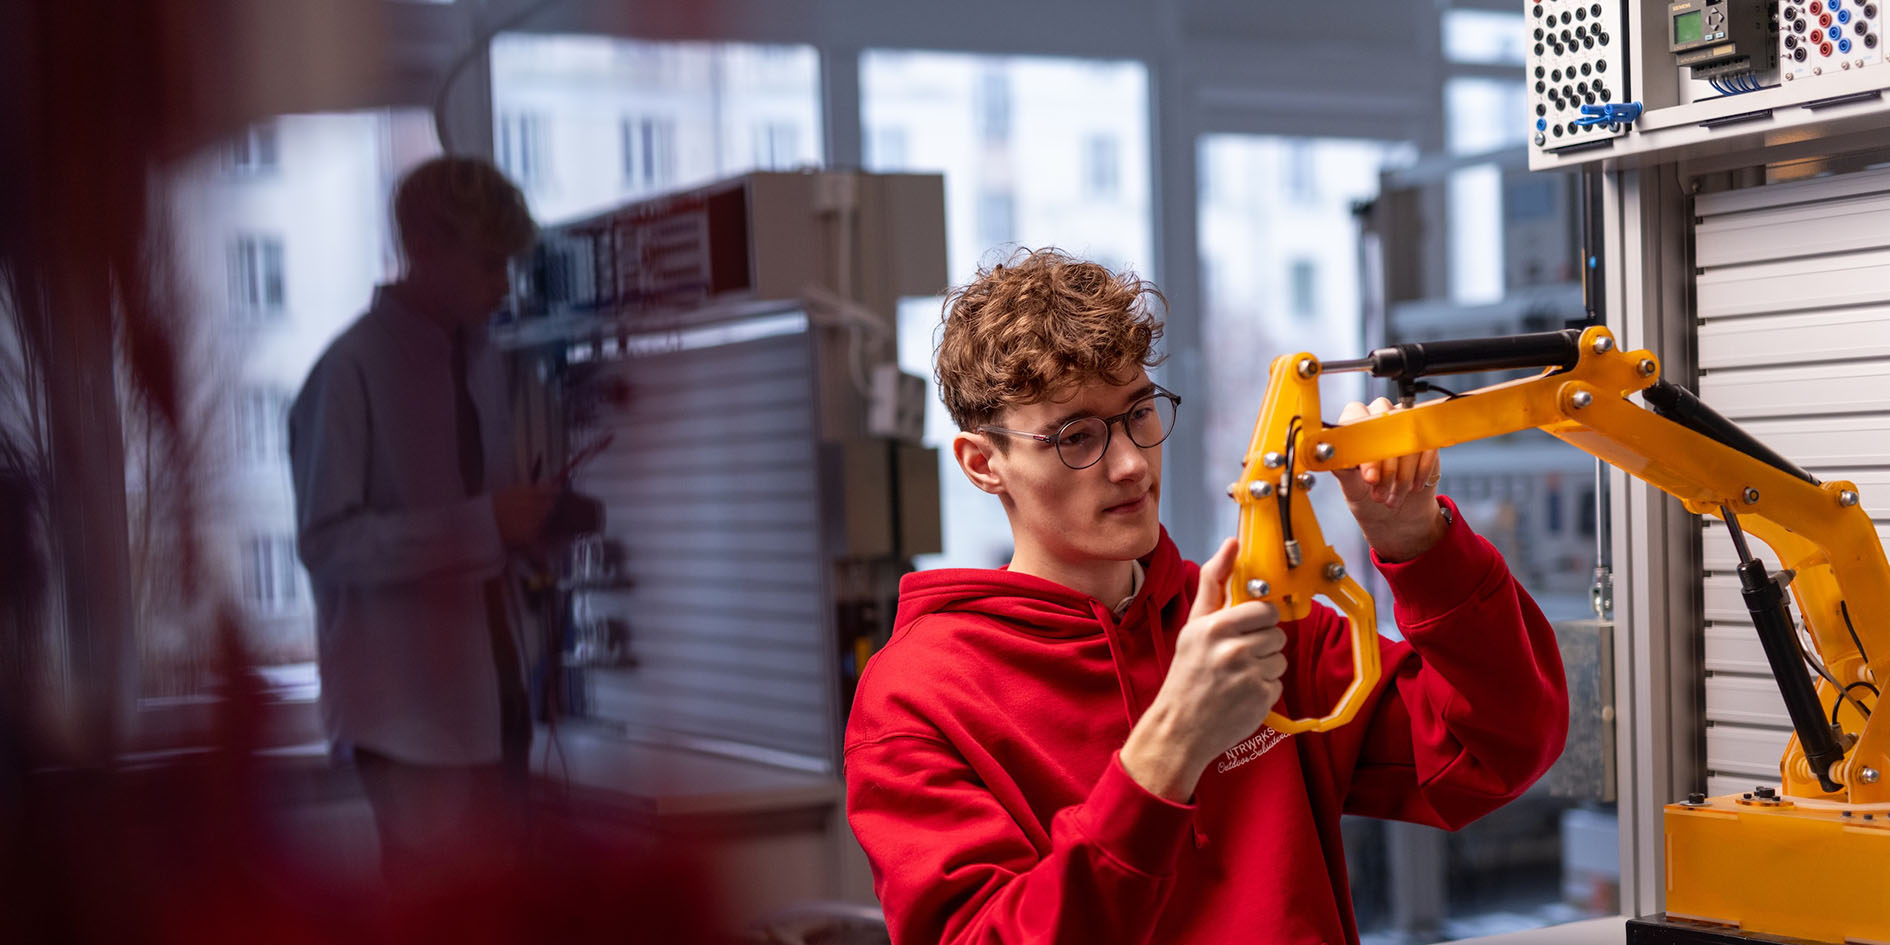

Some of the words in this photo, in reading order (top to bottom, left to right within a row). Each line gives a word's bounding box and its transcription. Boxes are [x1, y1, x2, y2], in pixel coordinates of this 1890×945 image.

[1672, 3, 1691, 11] SIEMENS
[1225, 727, 1275, 760] NTRWRKS
[1217, 756, 1250, 774] Outdoor
